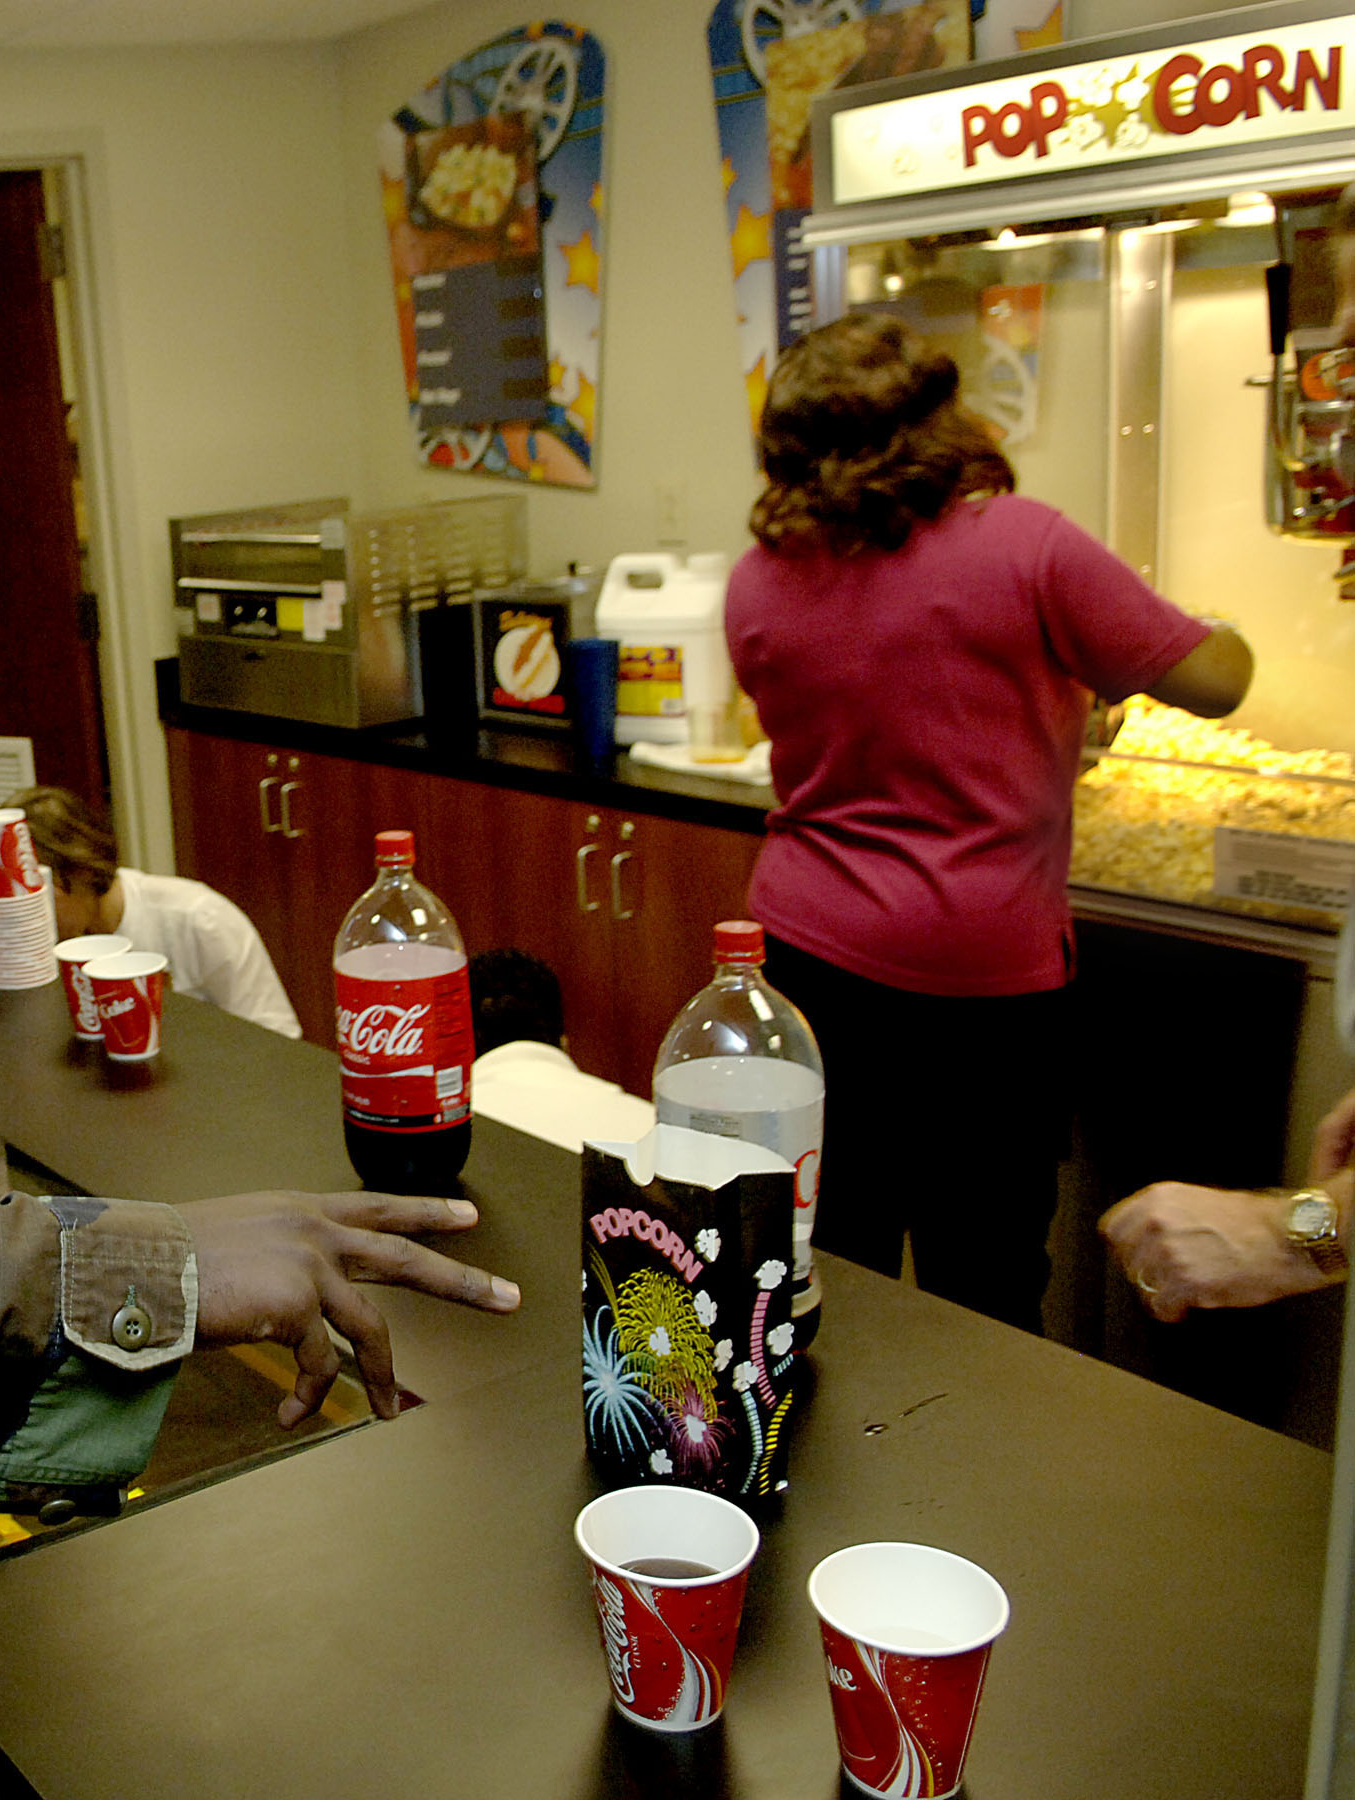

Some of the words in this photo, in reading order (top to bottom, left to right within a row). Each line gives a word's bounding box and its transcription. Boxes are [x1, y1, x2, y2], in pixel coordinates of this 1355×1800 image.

[961, 81, 1069, 168] POP
[1152, 44, 1342, 135] CORN
[589, 1206, 705, 1284] POPCORN
[827, 1654, 858, 1691] ke
